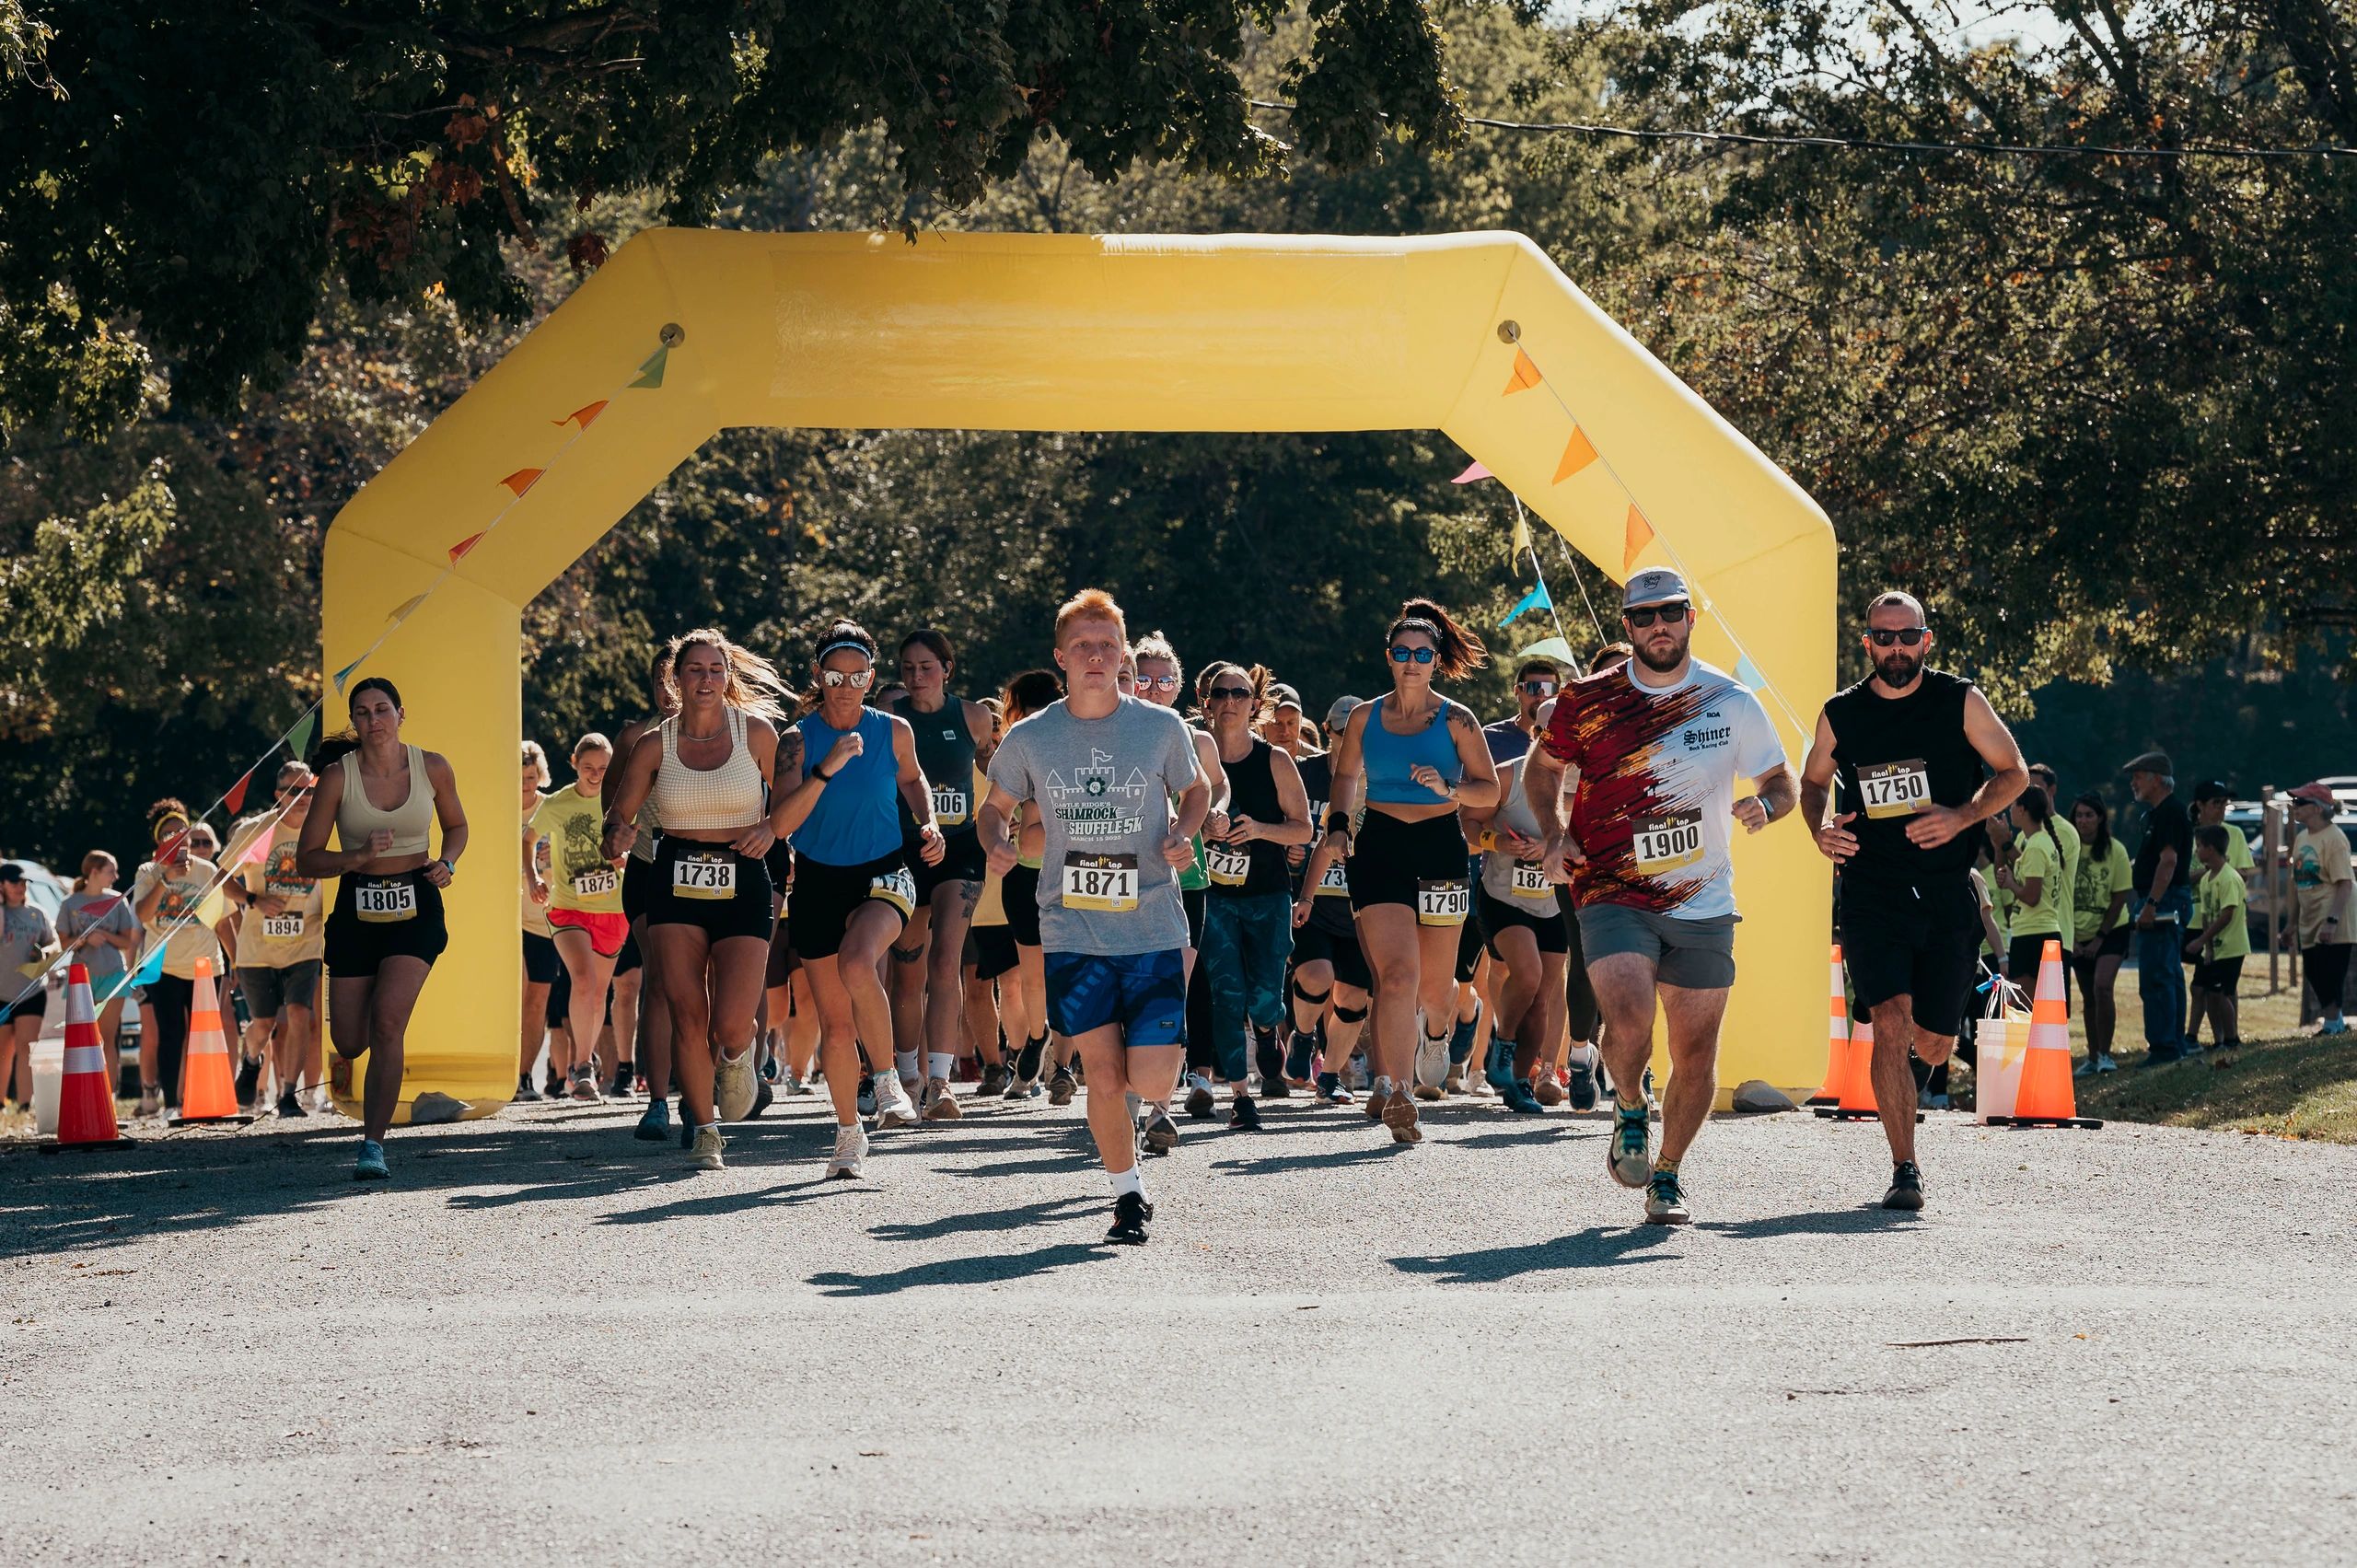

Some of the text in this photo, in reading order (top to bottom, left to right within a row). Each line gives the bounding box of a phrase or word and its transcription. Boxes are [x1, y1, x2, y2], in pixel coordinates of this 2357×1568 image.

[1683, 726, 1731, 746] Shiner
[1867, 775, 1923, 805] 1750
[1055, 807, 1119, 819] SHAMROCK
[1069, 816, 1144, 835] SHUFFLE 5K
[1642, 826, 1699, 860] 1900
[1206, 851, 1246, 875] 1712
[580, 874, 614, 894] 1875
[679, 864, 730, 888] 1738
[1071, 870, 1130, 897] 1871
[1320, 870, 1348, 886] 73
[362, 889, 411, 911] 1805
[1424, 892, 1468, 913] 1790
[267, 921, 300, 935] 1894
